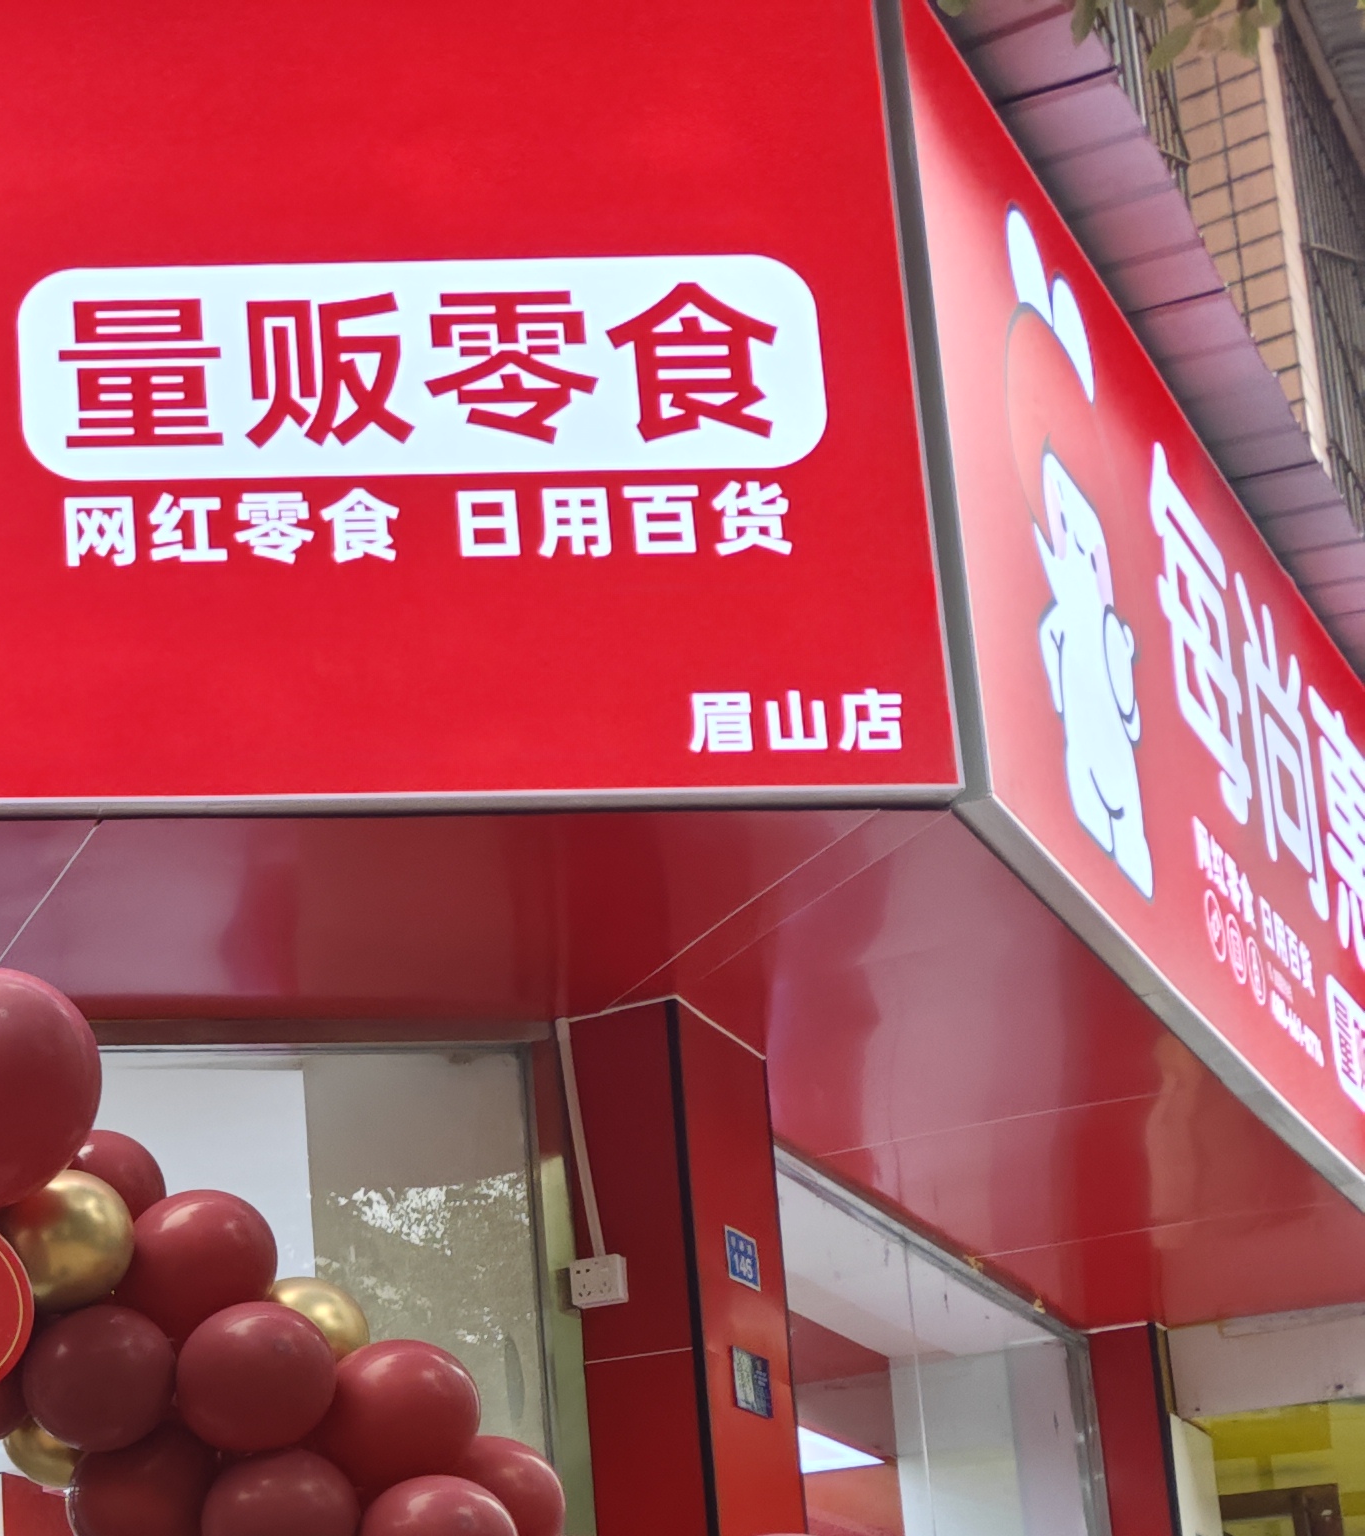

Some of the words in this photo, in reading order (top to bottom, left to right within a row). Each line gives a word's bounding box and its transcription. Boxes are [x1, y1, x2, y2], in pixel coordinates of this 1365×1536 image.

[59, 282, 777, 448] 量贩零食
[61, 487, 400, 567] 网红零食
[456, 480, 793, 559] 日用百货
[688, 689, 903, 753] 眉山店
